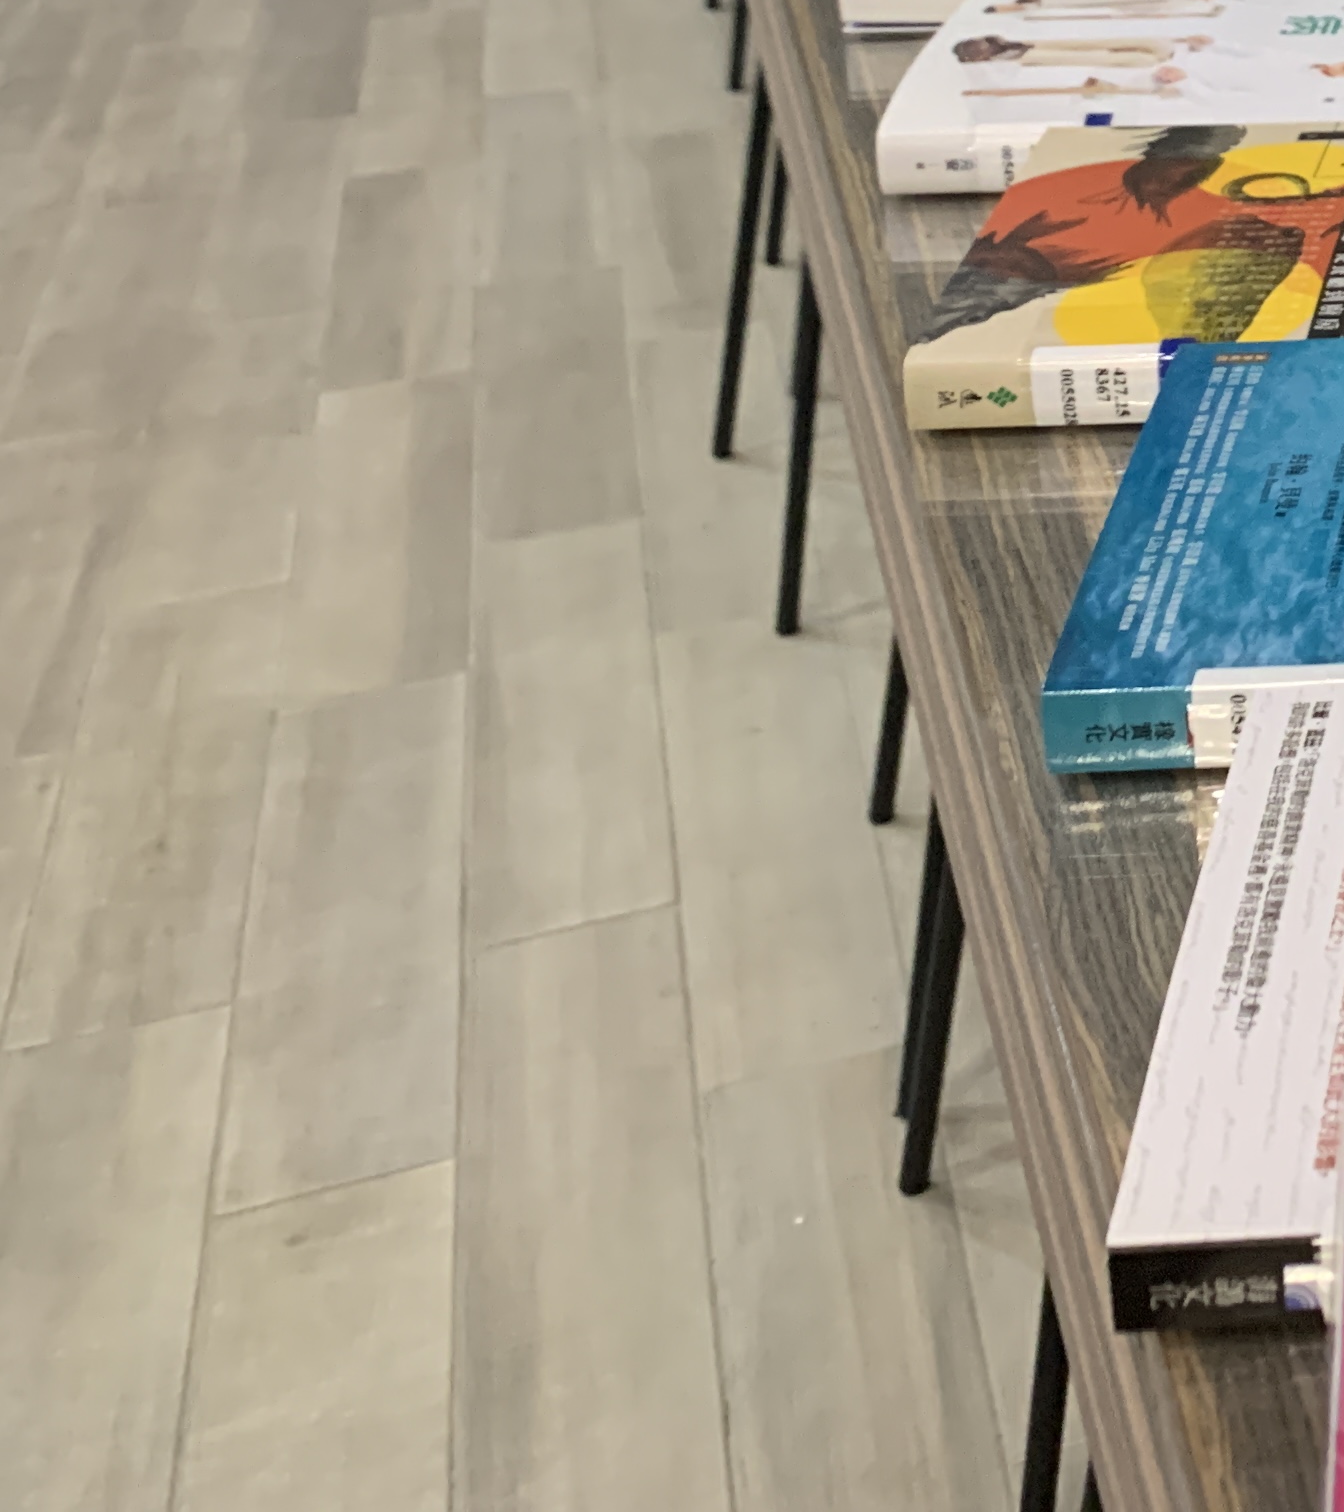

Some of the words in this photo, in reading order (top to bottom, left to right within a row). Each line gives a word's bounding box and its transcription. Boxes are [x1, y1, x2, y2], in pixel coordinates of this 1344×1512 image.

[1095, 368, 1111, 402] 8367
[1084, 721, 1176, 744] 橡實文化
